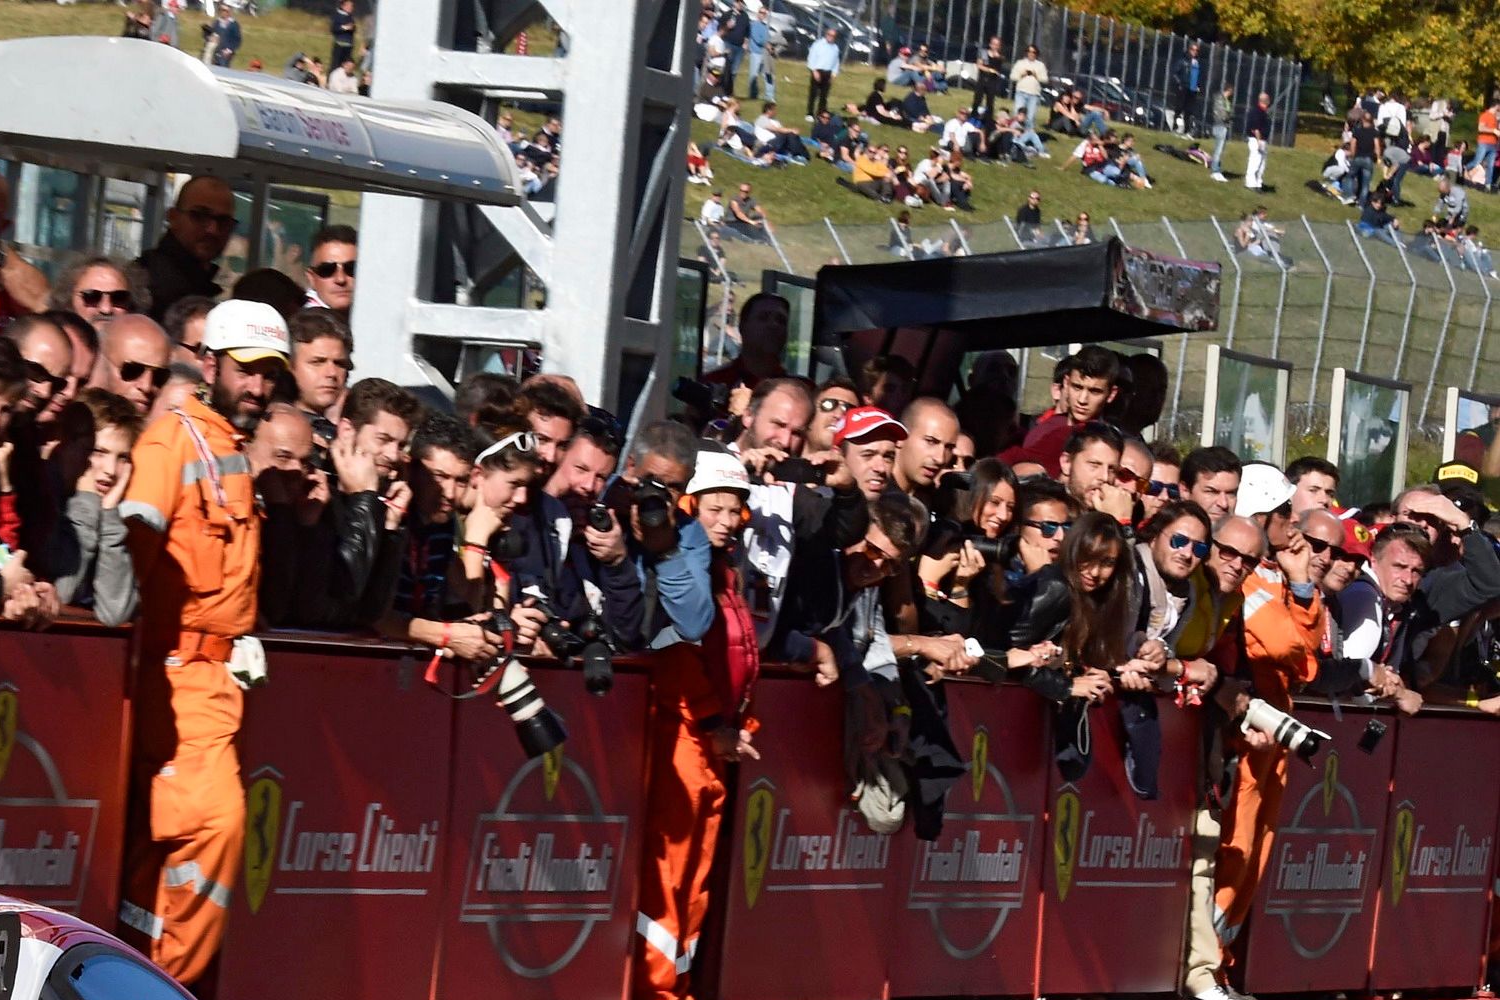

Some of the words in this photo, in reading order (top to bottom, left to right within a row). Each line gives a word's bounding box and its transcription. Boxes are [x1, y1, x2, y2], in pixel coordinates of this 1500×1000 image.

[279, 801, 356, 871] Corse
[357, 802, 439, 872] Clienti
[476, 833, 532, 891] Finali
[527, 833, 612, 891] Mondiali
[771, 808, 832, 870] Corse
[960, 830, 1024, 881] Mondiali
[1078, 810, 1133, 868] Corse
[1133, 812, 1185, 868] Clienti
[1409, 824, 1452, 876] Corse
[1451, 824, 1492, 876] Clienti
